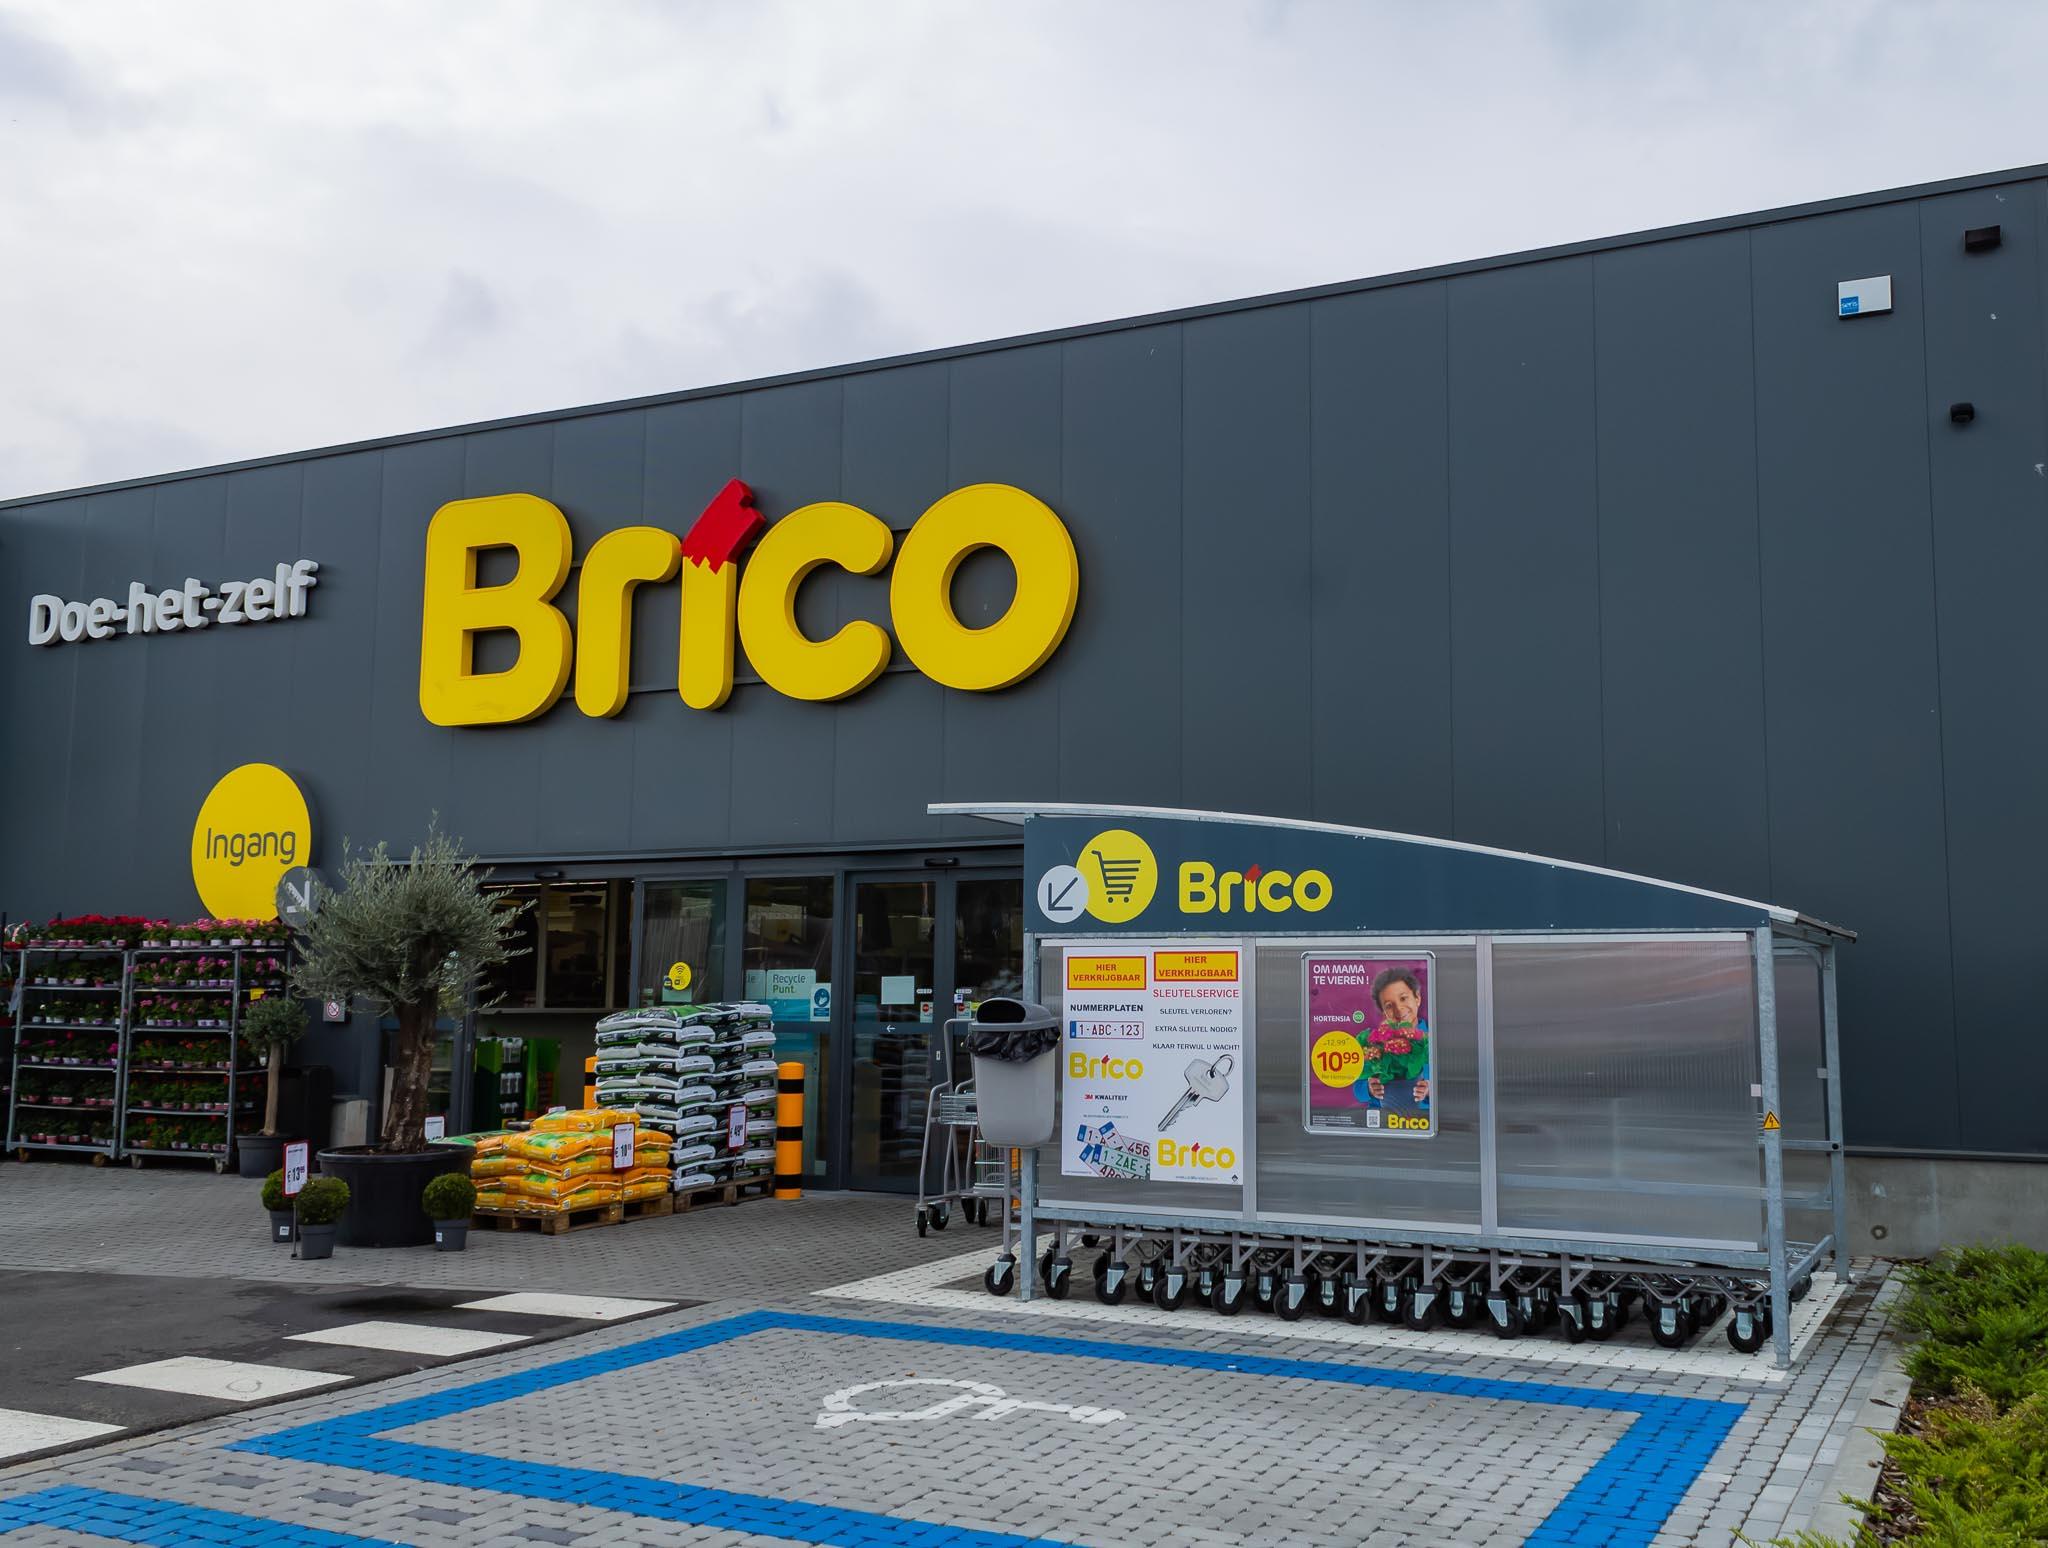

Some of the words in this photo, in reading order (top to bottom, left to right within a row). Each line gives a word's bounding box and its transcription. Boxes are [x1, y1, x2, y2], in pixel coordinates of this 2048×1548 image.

[29, 559, 319, 645] Doe-het-zelf
[420, 478, 1080, 728] Brico
[206, 827, 296, 867] Ingang
[1178, 862, 1333, 914] Brico
[1184, 955, 1207, 964] HIER
[1096, 963, 1117, 972] HIER
[1313, 964, 1330, 974] OM
[1332, 964, 1365, 974] MAMA
[1073, 973, 1141, 982] VERKRIJGBAAR
[1158, 969, 1234, 978] VERKRIJGBAAR
[772, 974, 806, 985] Recycle
[1313, 976, 1326, 985] TE
[1327, 975, 1364, 985] VIEREN
[1153, 988, 1240, 998] SLEUTELSERVICE
[1070, 1003, 1144, 1012] NUMMERPLATEN
[1190, 1008, 1233, 1016] VERLOREN?
[1069, 1051, 1144, 1080] Brico
[1387, 1113, 1429, 1130] Brico
[1157, 1138, 1236, 1170] Brico
